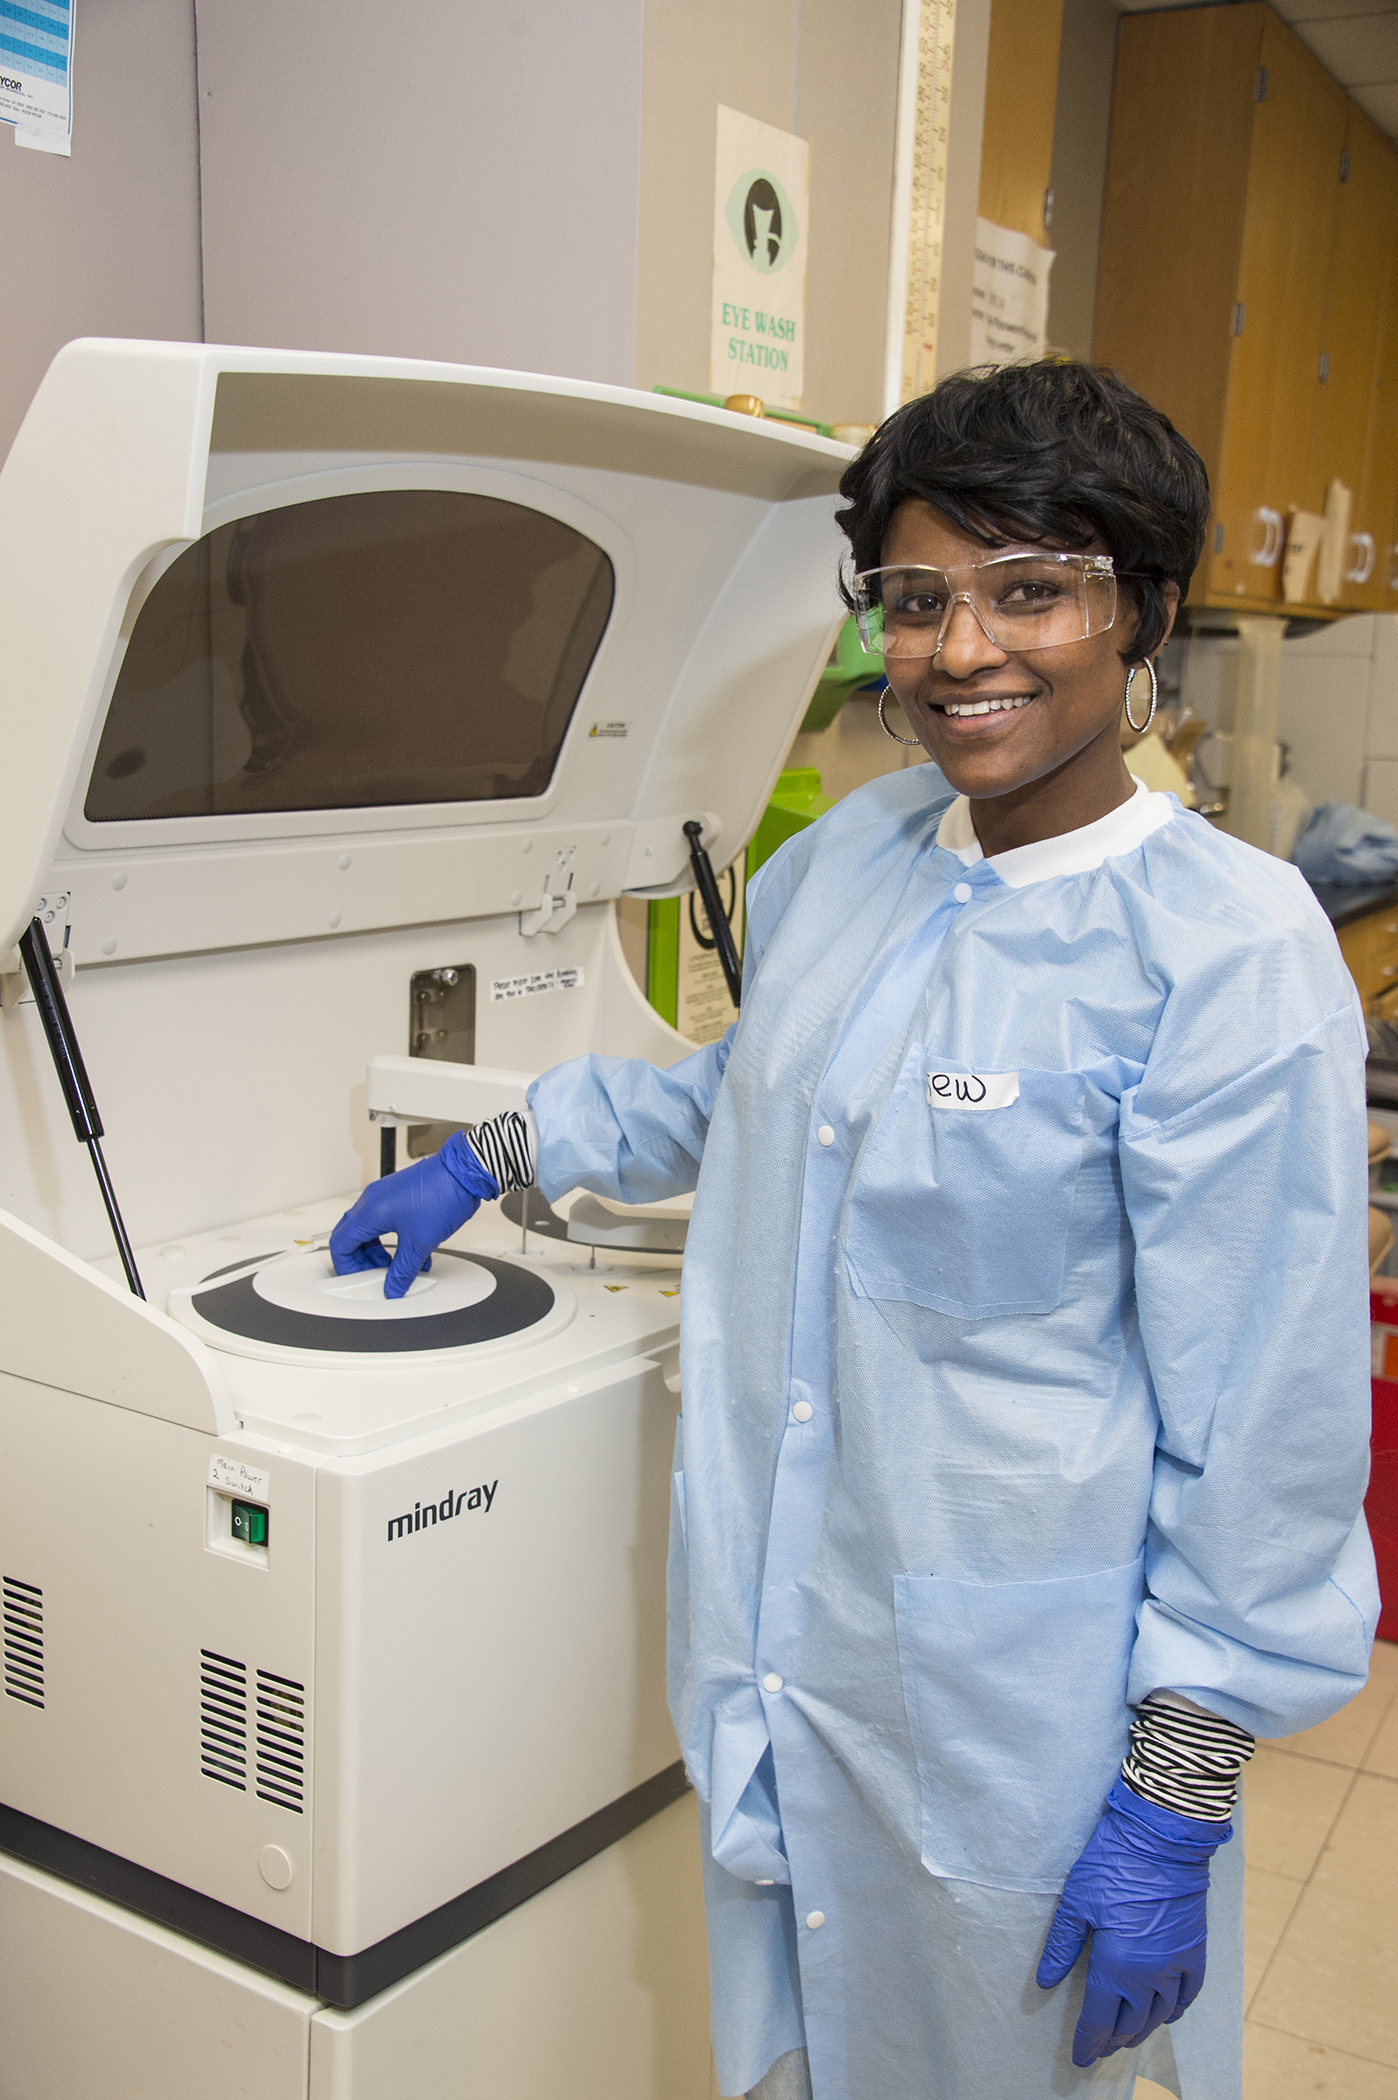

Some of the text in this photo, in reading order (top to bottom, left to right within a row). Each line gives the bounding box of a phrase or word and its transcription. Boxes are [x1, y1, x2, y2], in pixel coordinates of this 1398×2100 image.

[722, 302, 796, 342] EYE WASH
[728, 338, 788, 372] STATION
[927, 1073, 986, 1103] ew
[213, 1468, 219, 1480] 2
[240, 1464, 263, 1484] Power
[388, 1479, 499, 1542] mindray
